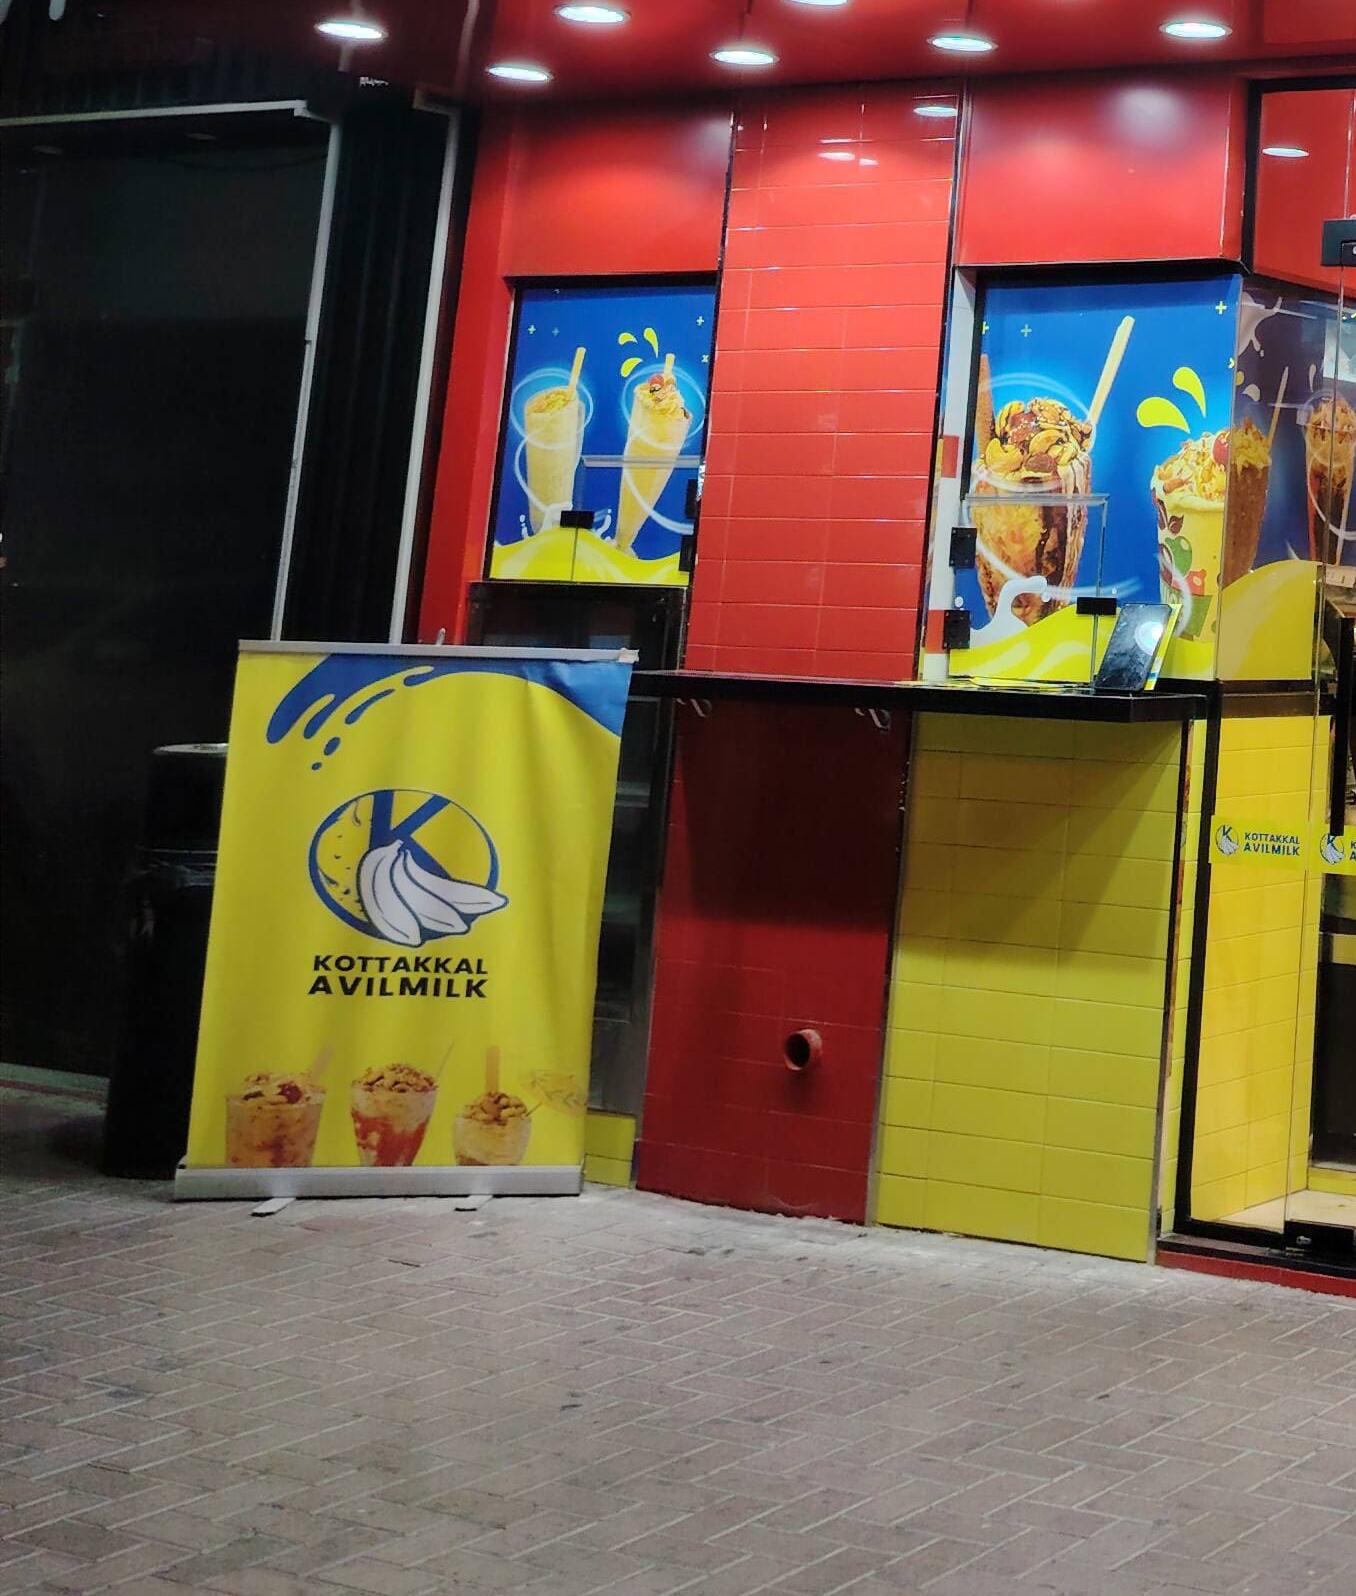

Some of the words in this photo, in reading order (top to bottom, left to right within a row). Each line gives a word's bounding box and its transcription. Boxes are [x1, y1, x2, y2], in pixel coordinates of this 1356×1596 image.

[1244, 832, 1300, 845] KOTTAKKAL
[1243, 843, 1300, 856] AVILMILK
[313, 955, 488, 975] KOTTAKKAL
[308, 975, 488, 998] AVILMILK
